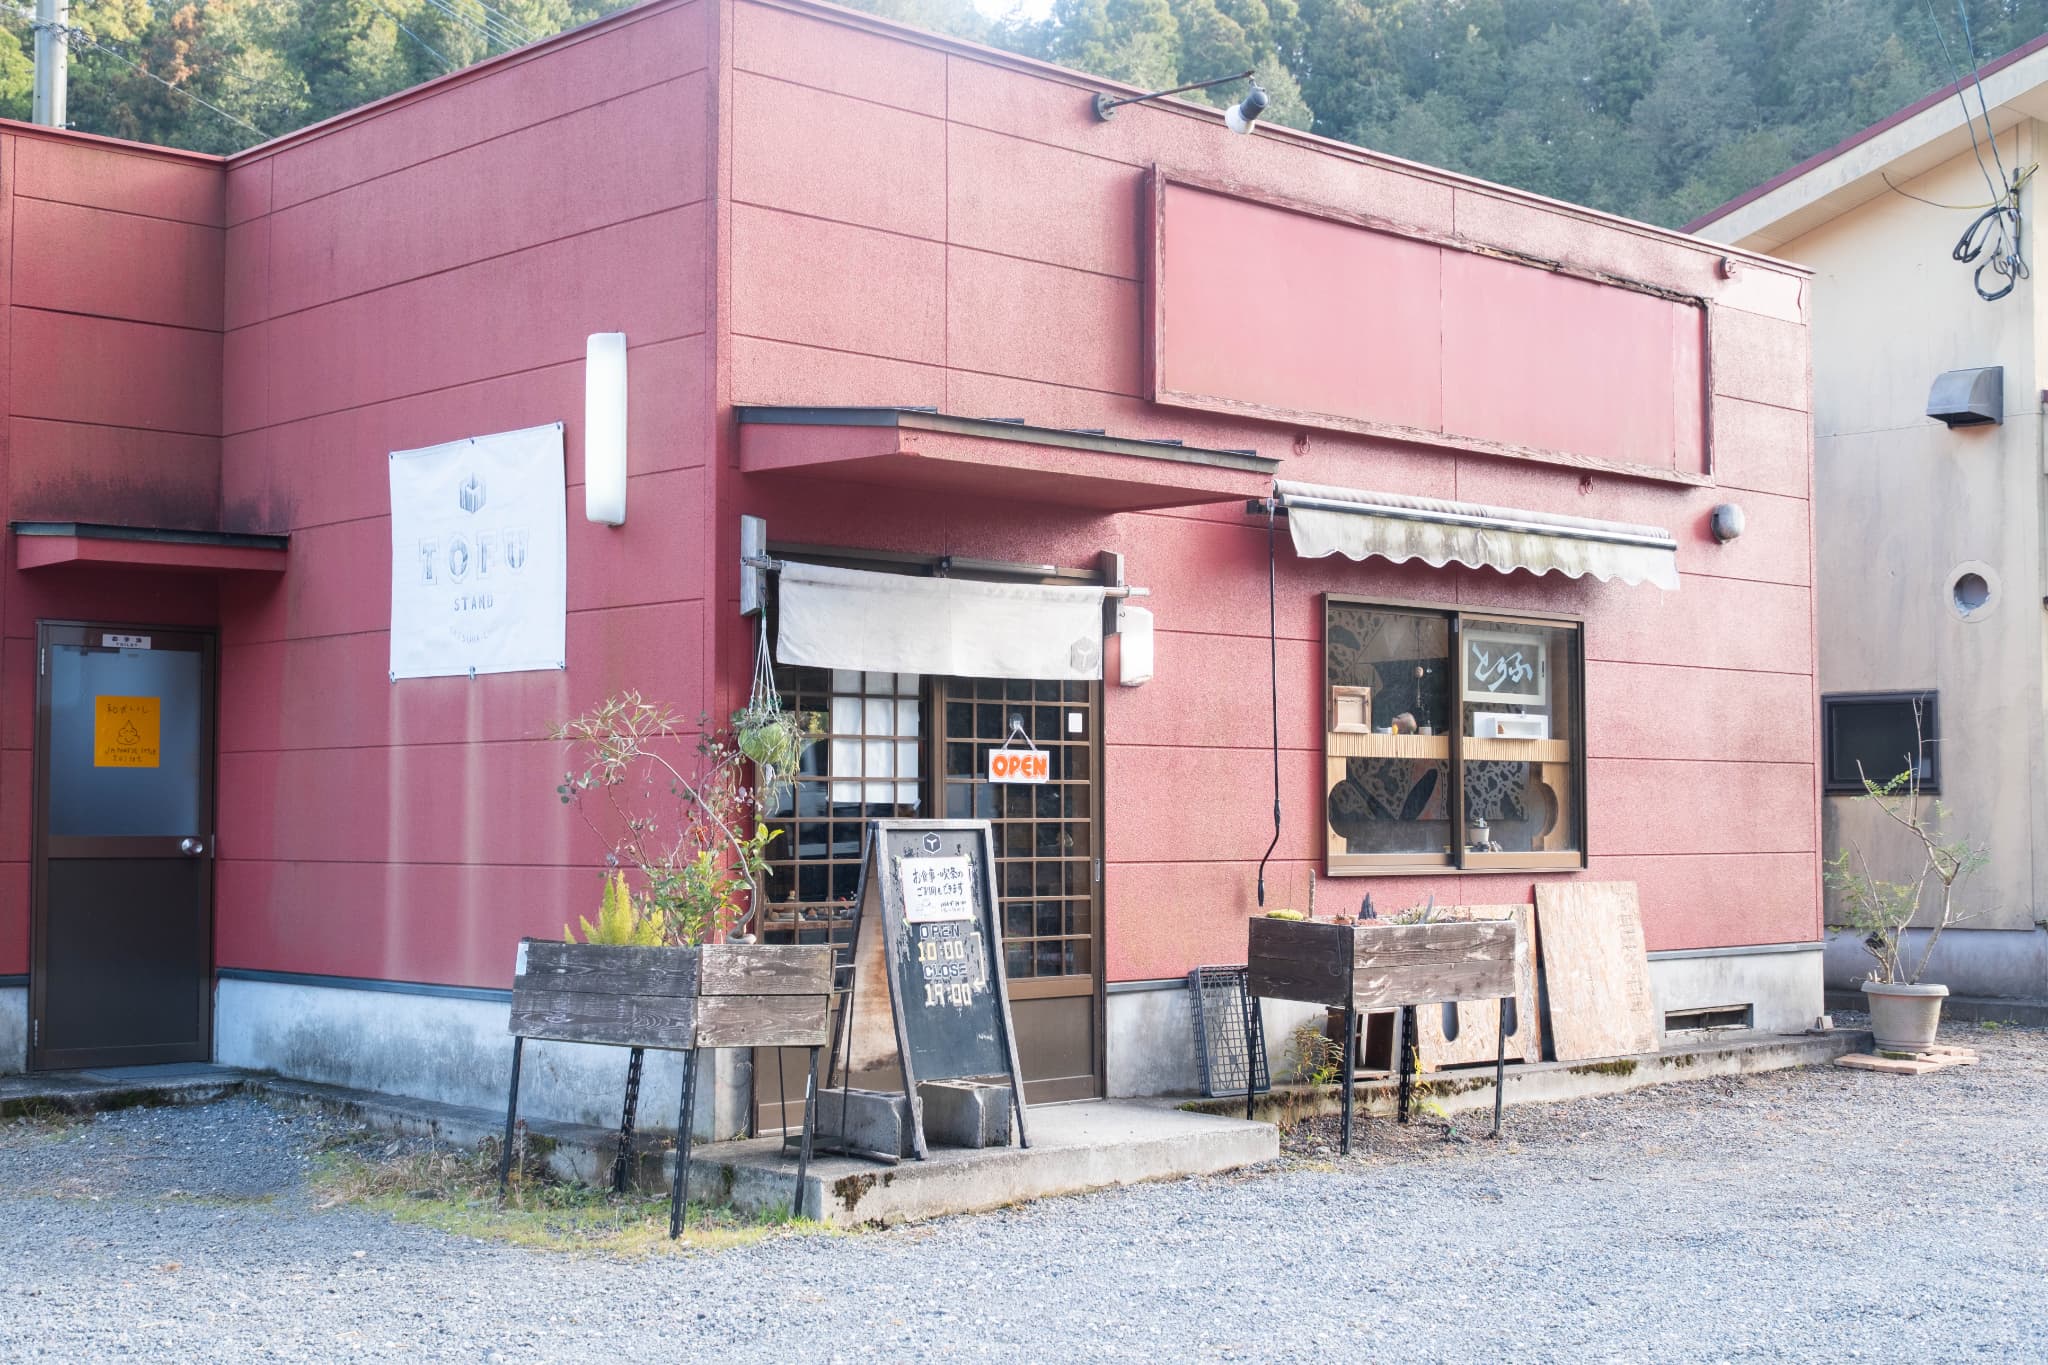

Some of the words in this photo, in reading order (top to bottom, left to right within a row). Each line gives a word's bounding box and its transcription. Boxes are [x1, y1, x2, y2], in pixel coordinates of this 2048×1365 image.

[418, 527, 529, 586] TOFU
[454, 592, 494, 611] STAND
[992, 754, 1047, 779] OPEN
[920, 924, 961, 939] OPEN
[918, 941, 964, 962] 10:00
[923, 963, 968, 979] CLOSE
[925, 983, 972, 1007] 19:00
